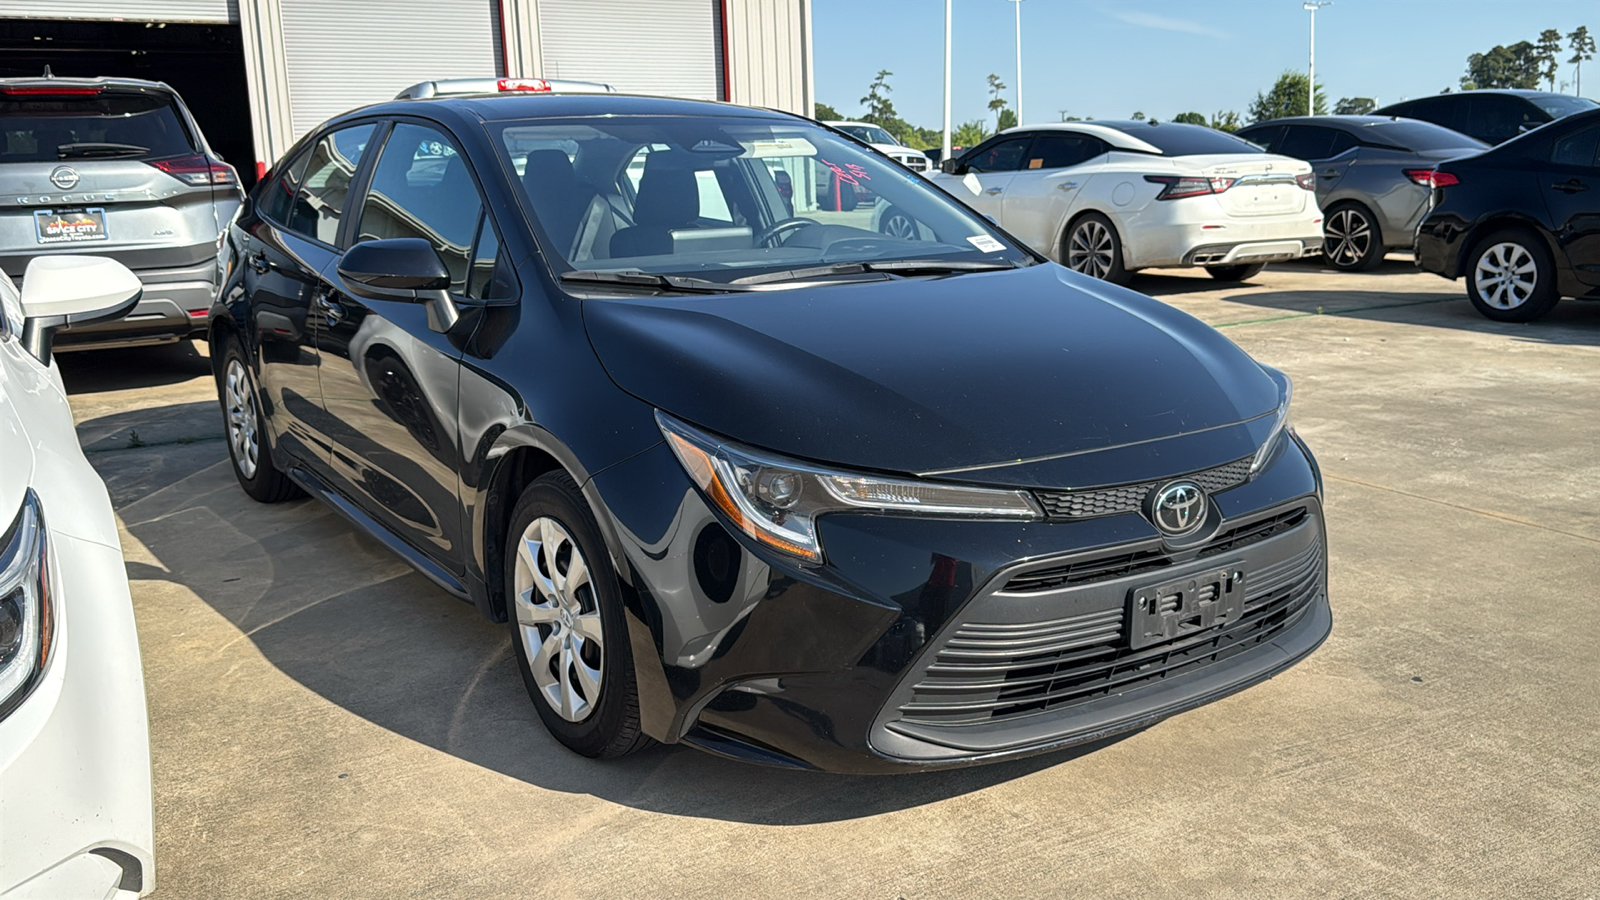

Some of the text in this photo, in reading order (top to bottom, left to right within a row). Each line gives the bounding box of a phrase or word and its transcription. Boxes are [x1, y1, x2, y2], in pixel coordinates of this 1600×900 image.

[17, 193, 116, 204] ROGUE
[46, 224, 76, 234] SPACE
[76, 224, 98, 232] CITY
